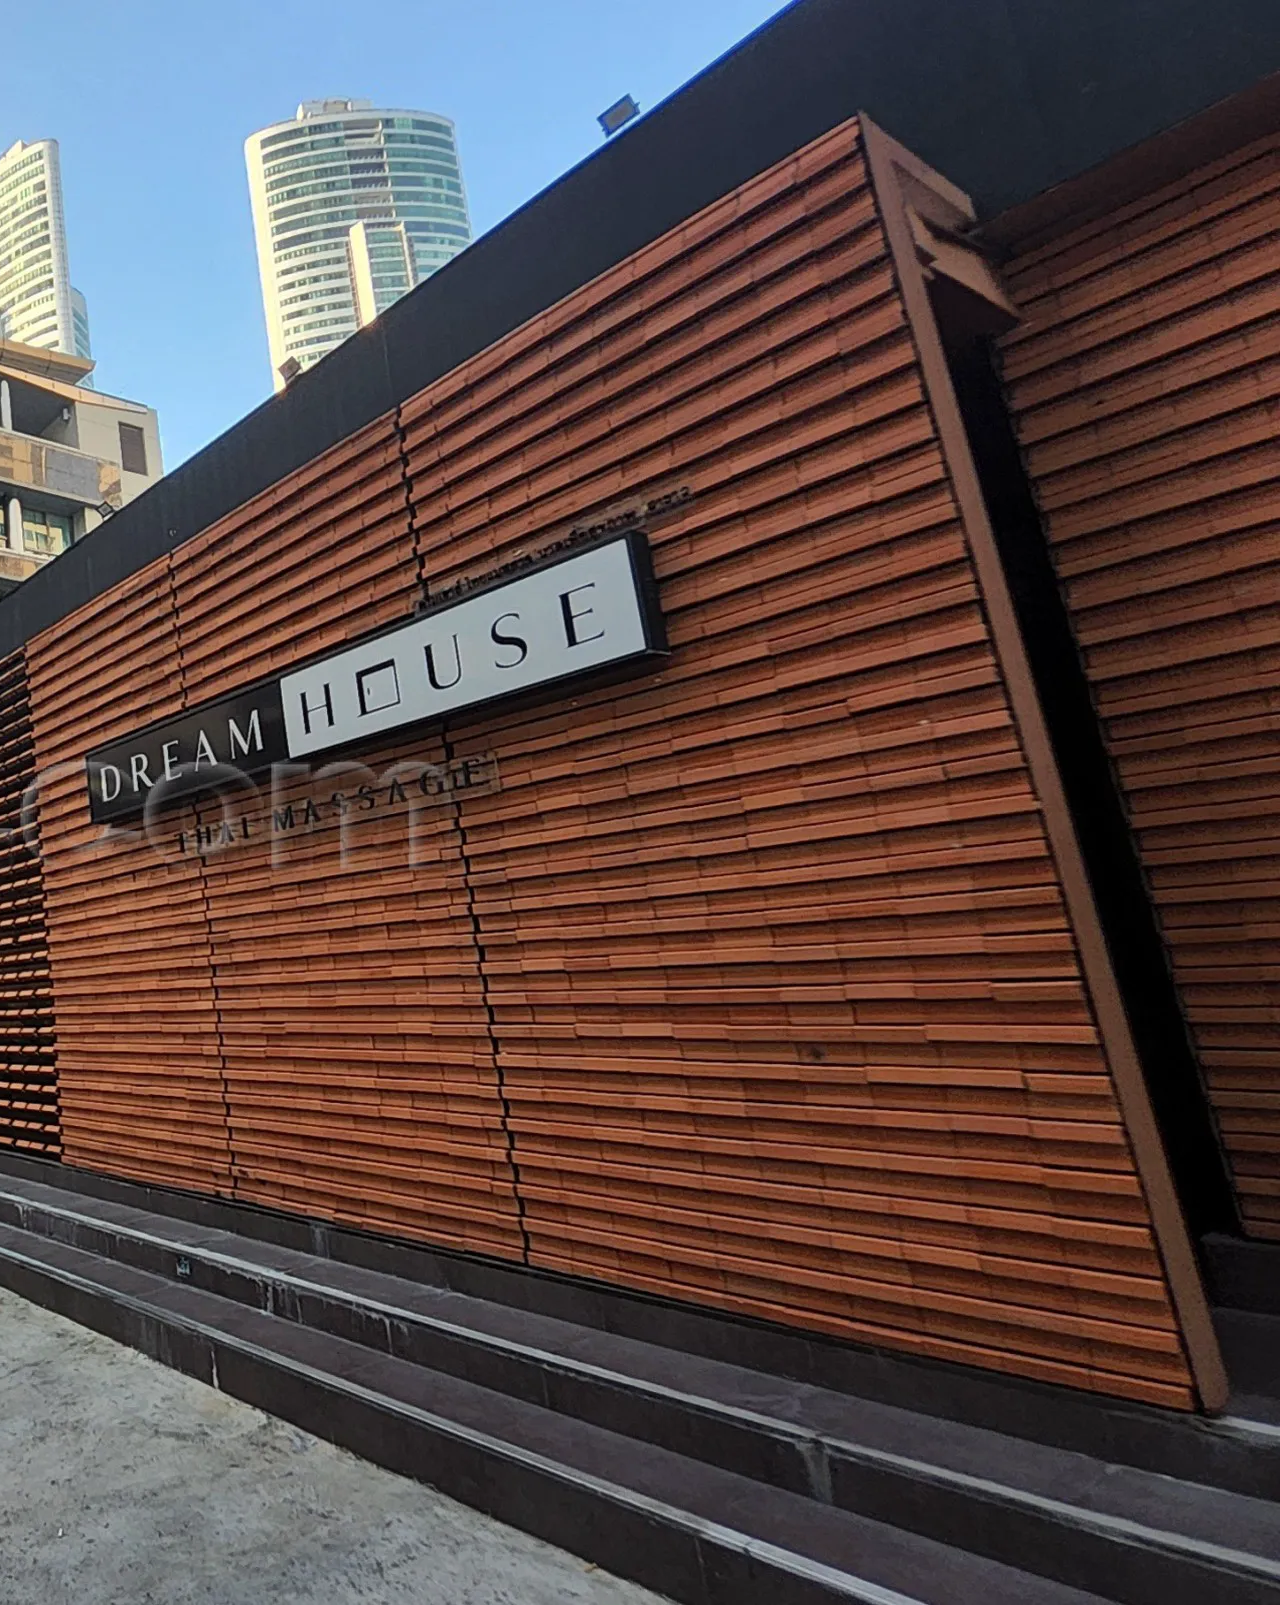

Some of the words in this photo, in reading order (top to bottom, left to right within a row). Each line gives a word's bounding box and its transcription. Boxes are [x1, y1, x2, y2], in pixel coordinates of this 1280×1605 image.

[99, 708, 265, 803] DREAM
[175, 816, 251, 853] THAI
[272, 757, 483, 832] MASSAGE
